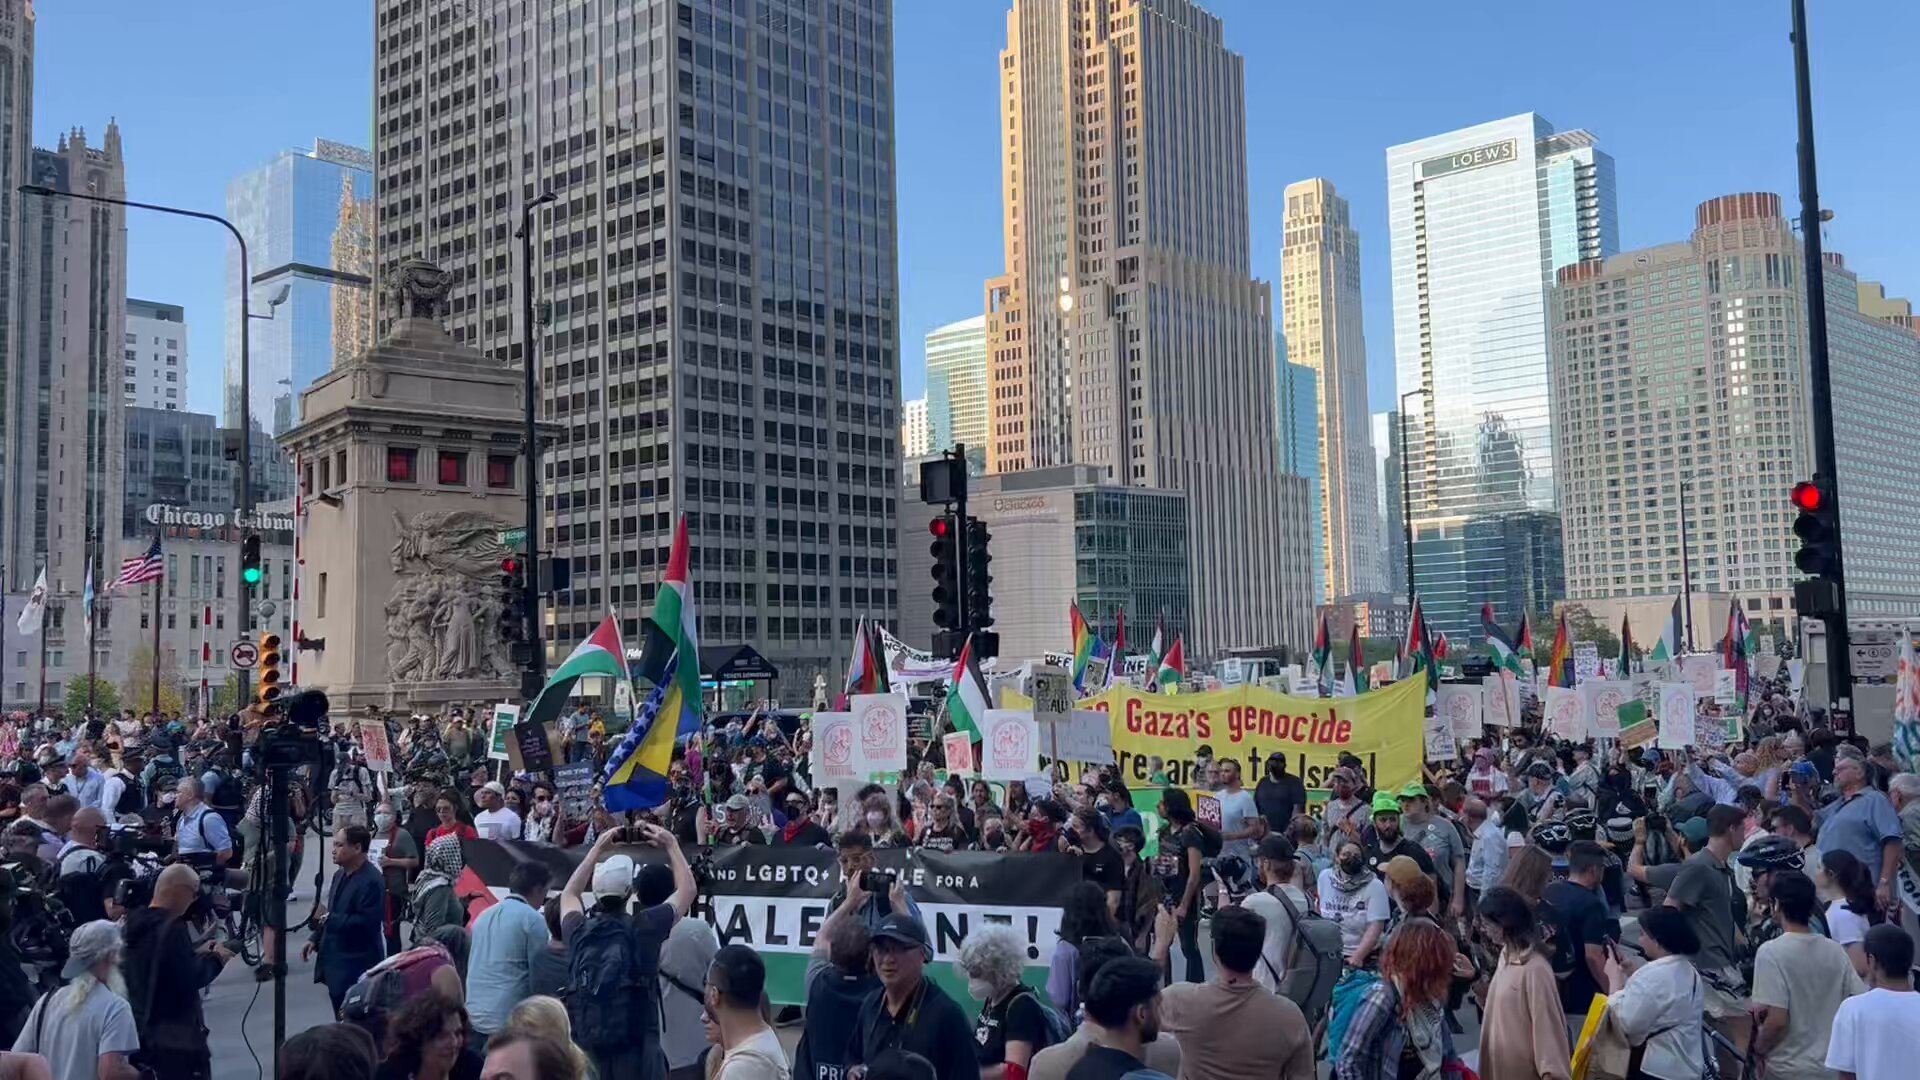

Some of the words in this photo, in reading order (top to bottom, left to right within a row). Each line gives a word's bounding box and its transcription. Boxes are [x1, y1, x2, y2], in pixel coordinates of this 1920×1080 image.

[1451, 143, 1511, 168] LOEWS
[146, 503, 225, 529] Chicago
[234, 508, 295, 531] Tibun
[1126, 698, 1211, 739] Gaza's
[1228, 705, 1352, 744] genocide
[745, 864, 829, 886] LGBTQ+
[936, 875, 964, 888] FOR
[969, 876, 979, 888] A
